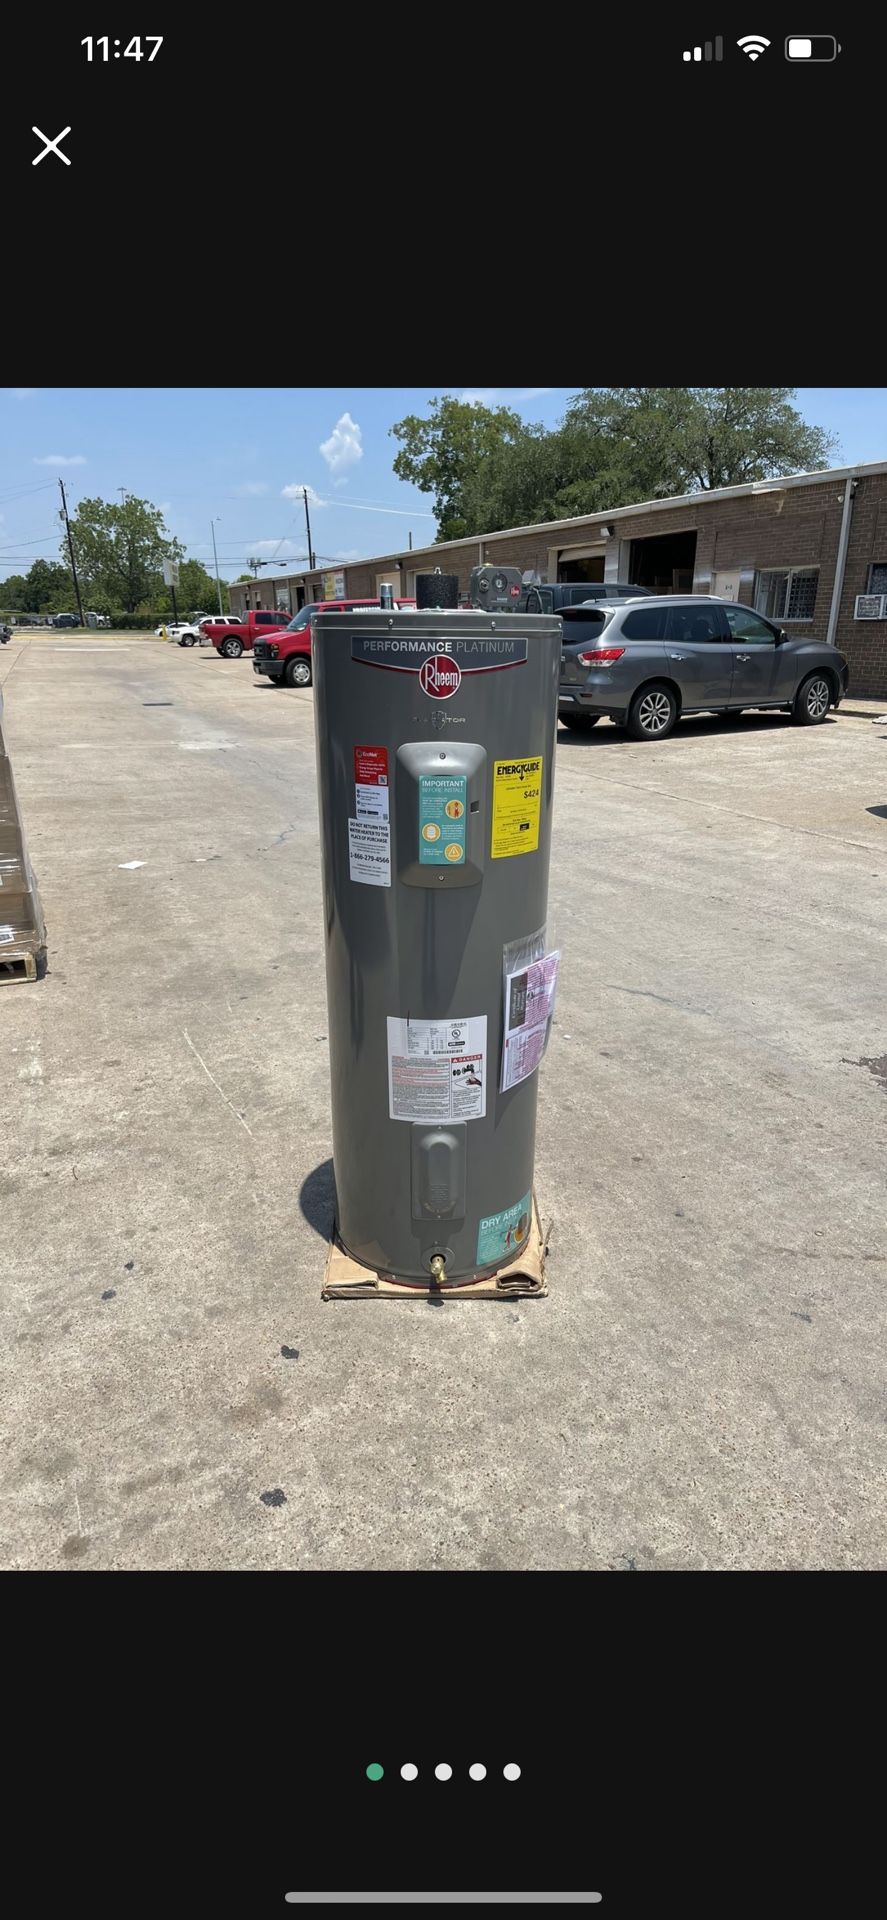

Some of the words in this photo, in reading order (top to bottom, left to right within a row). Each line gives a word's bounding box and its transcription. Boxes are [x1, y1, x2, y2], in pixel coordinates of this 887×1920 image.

[363, 640, 452, 653] PERFORMANCE
[456, 641, 515, 653] PLATINUM
[424, 656, 458, 692] Rheem
[421, 780, 464, 788] IMPORTANT
[523, 788, 540, 799] $424
[481, 1215, 501, 1230] DRY
